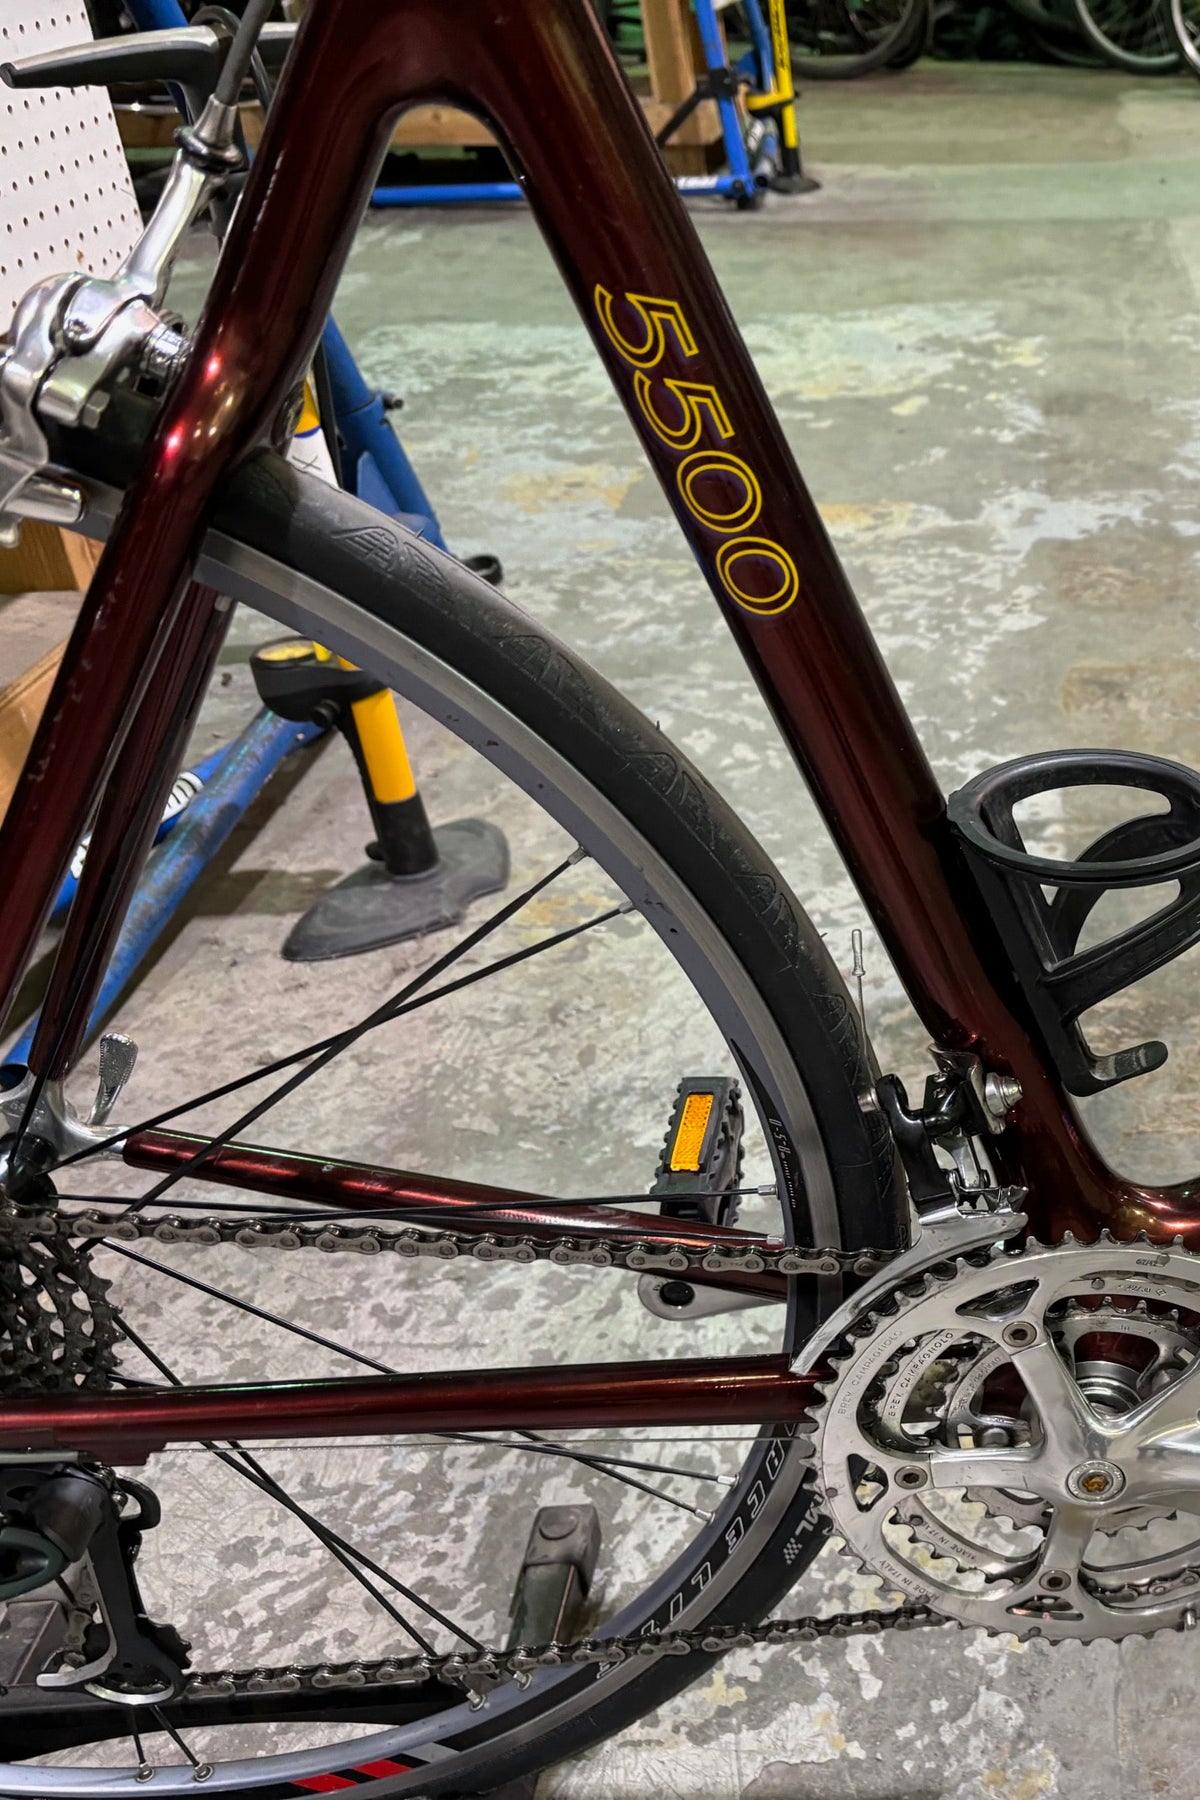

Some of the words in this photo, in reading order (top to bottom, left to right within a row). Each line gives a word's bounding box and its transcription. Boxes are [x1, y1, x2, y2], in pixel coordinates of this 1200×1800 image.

[594, 283, 799, 615] 5500
[851, 1330, 903, 1388] CAMPAGNOLO
[900, 1331, 955, 1389] CAMPAGNOLO
[901, 1576, 913, 1587] IN
